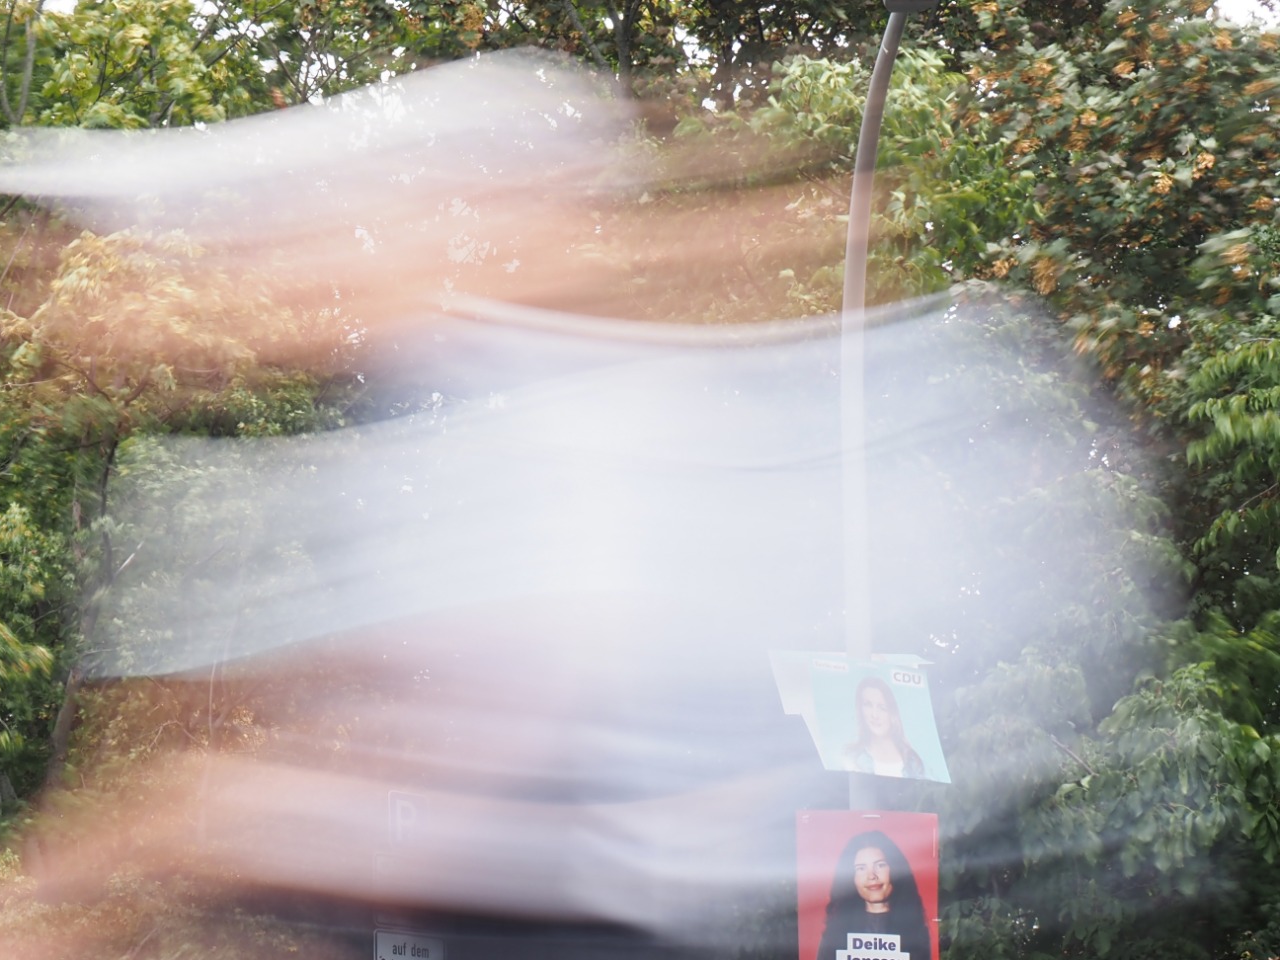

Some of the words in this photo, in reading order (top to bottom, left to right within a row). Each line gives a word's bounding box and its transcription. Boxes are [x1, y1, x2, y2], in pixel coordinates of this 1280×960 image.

[893, 671, 922, 685] CDU
[396, 800, 417, 840] P
[392, 942, 407, 956] auf
[411, 944, 430, 958] dem
[852, 938, 896, 951] Deike
